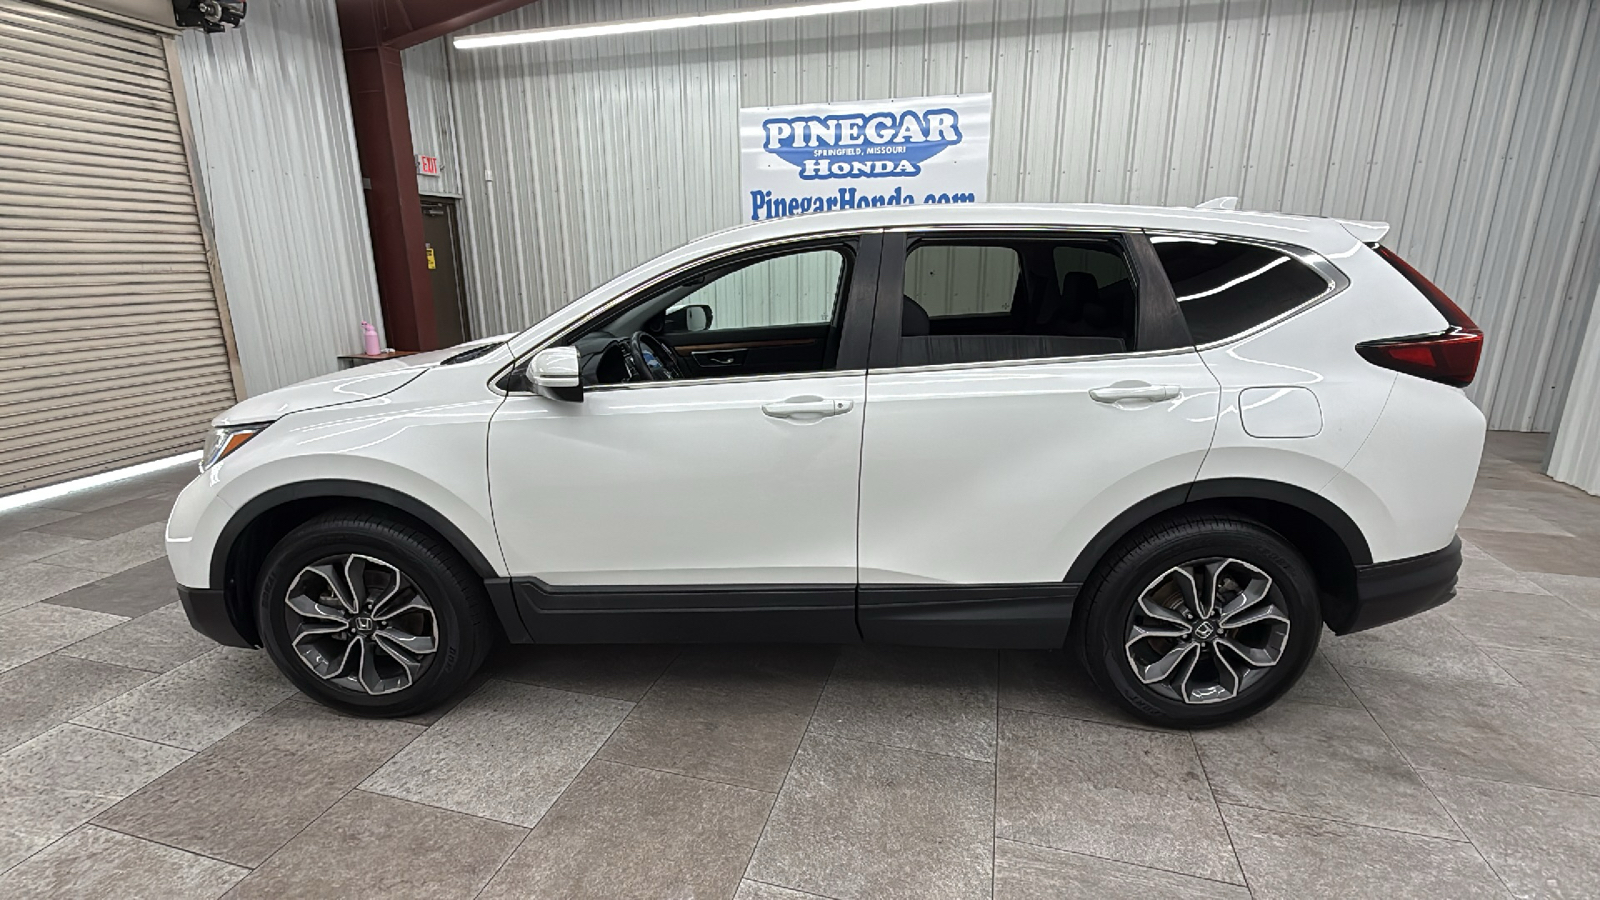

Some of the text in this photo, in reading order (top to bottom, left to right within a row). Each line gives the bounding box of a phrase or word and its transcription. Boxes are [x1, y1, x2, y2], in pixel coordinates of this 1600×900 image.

[766, 113, 959, 149] PINEGAR
[813, 146, 906, 157] SPRINGFIELD, MISSOURI
[421, 156, 437, 173] EXIT
[802, 160, 917, 176] HONDA
[750, 186, 975, 220] PinegarHondacom
